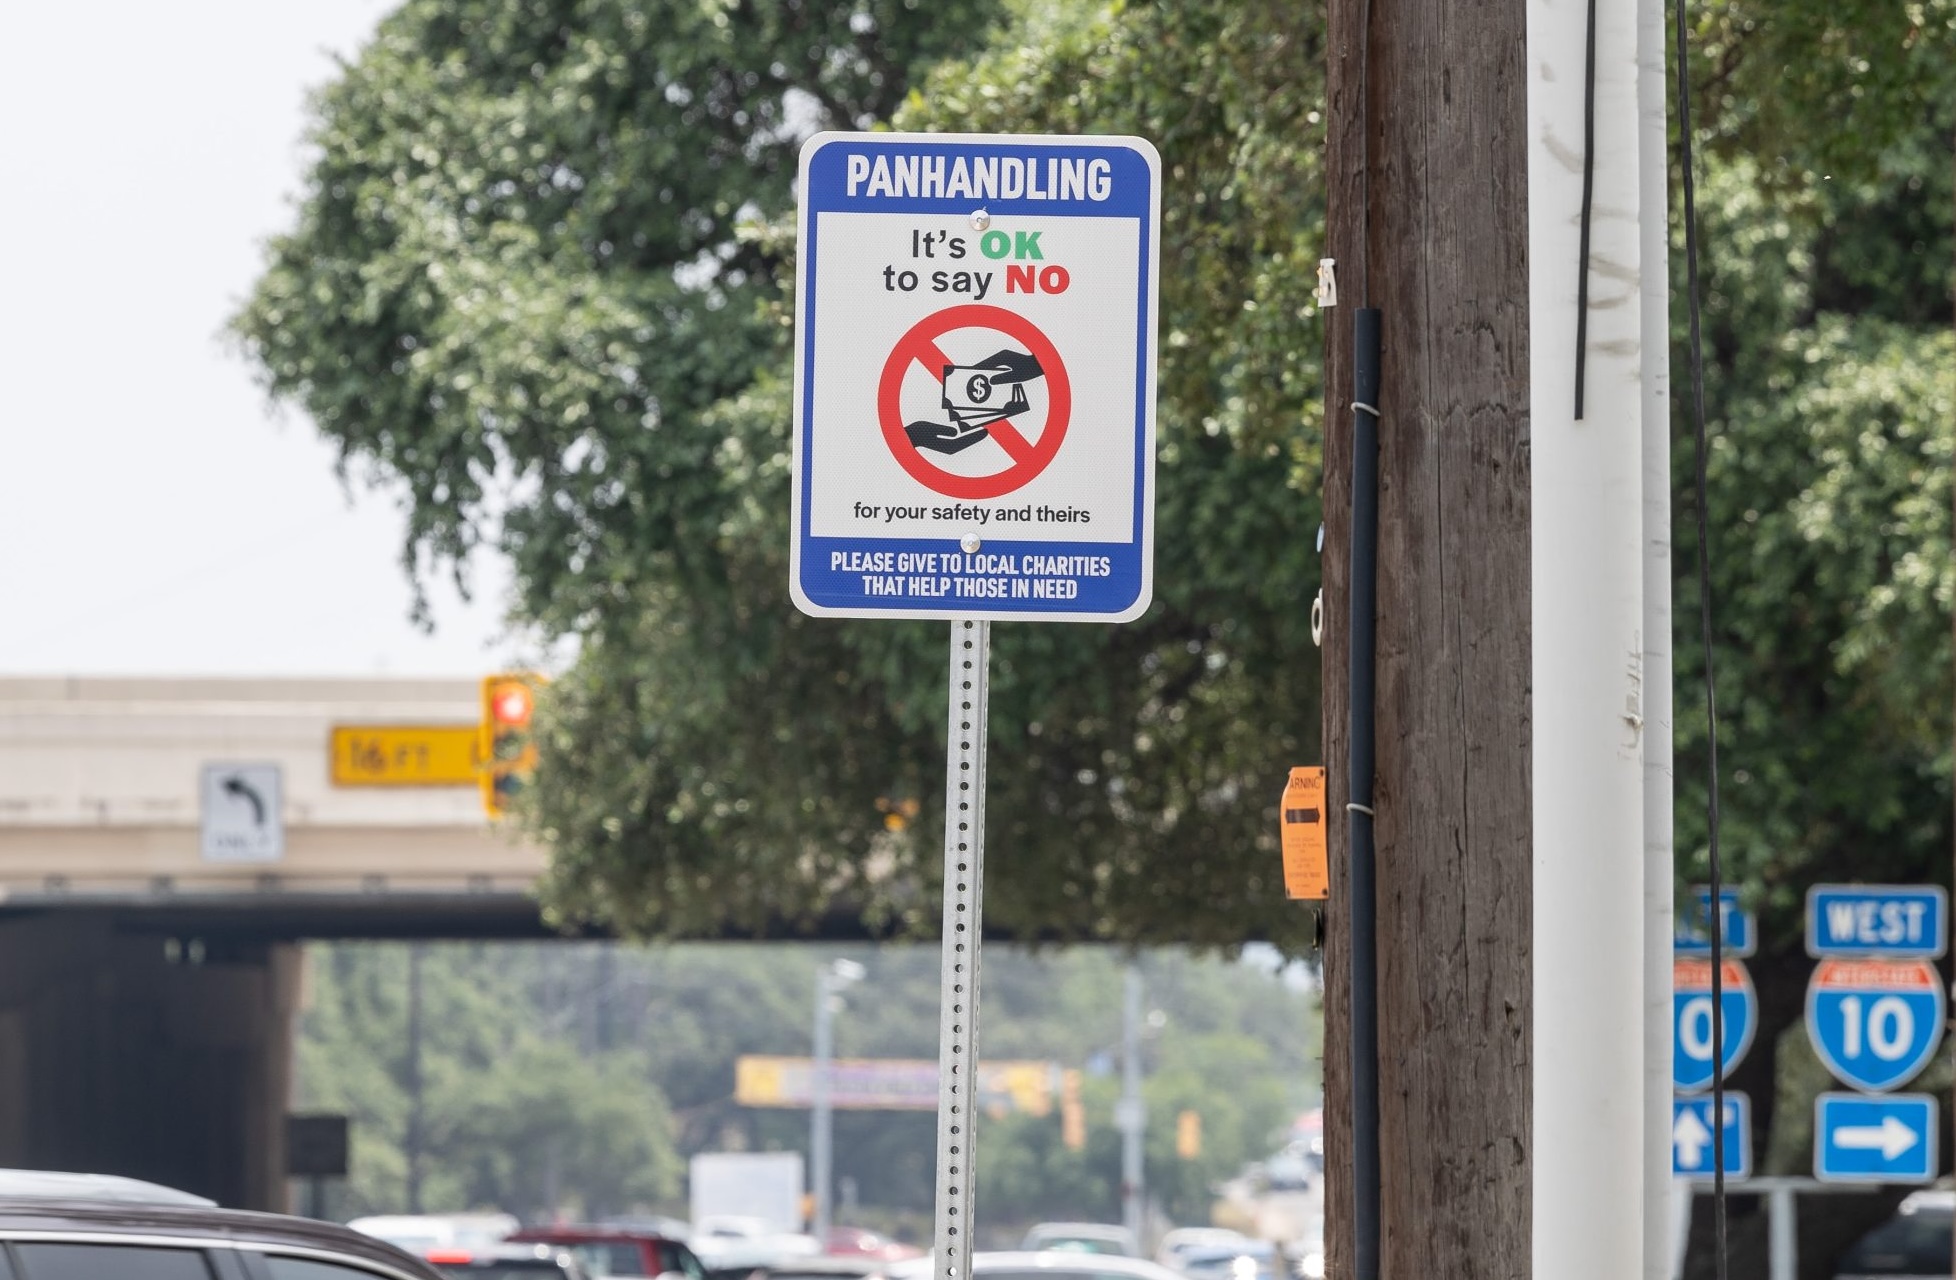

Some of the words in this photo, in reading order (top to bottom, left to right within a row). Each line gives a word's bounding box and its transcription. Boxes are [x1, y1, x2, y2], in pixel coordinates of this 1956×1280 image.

[847, 155, 1111, 201] PANHANDLING
[913, 230, 966, 259] It’s
[980, 230, 1043, 260] OK
[883, 265, 918, 291] to
[932, 271, 993, 300] say
[1007, 265, 1070, 294] NO
[854, 502, 881, 518] for
[885, 507, 927, 522] your
[932, 504, 990, 525] safety
[996, 505, 1030, 521] and
[1036, 505, 1090, 522] theirs
[832, 552, 894, 572] PLEASE
[898, 553, 937, 573] GIVE
[940, 553, 961, 573] TO
[966, 554, 1019, 574] LOCAL
[1023, 556, 1110, 576] CHARITIES
[862, 576, 905, 595] THAT
[909, 577, 950, 596] HELP
[954, 578, 1007, 597] THOSE
[1012, 579, 1029, 597] IN
[1034, 579, 1077, 599] NEED
[348, 735, 387, 772] 16
[1289, 776, 1321, 790] ARNING
[1826, 900, 1926, 944] WEST
[1678, 995, 1727, 1062] 0
[1838, 995, 1916, 1063] 10
